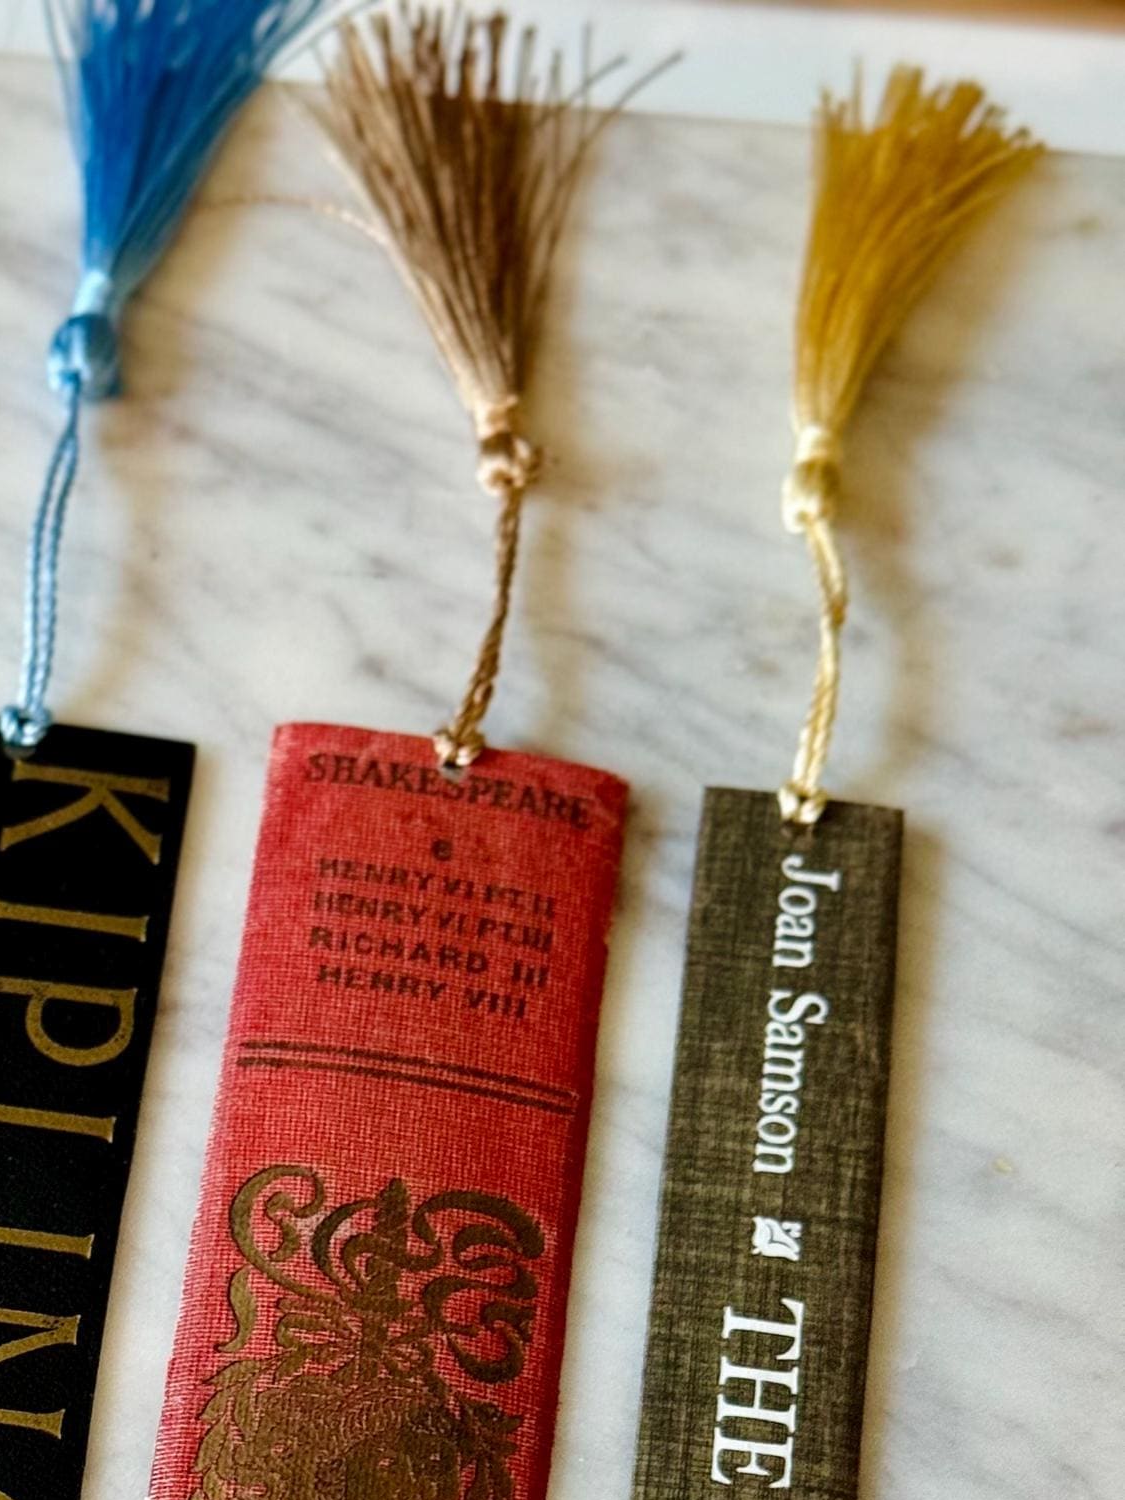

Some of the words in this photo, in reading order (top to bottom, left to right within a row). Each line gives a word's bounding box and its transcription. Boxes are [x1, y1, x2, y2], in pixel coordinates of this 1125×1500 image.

[305, 753, 590, 830] SHAKESPEARE
[318, 857, 433, 891] HENRY
[314, 890, 427, 925] HENRY
[772, 854, 842, 970] Joan
[309, 926, 488, 975] RICHARD
[317, 964, 447, 999] HENRY
[465, 987, 527, 1020] VIII
[752, 989, 829, 1175] Samson
[710, 1300, 805, 1490] THE
